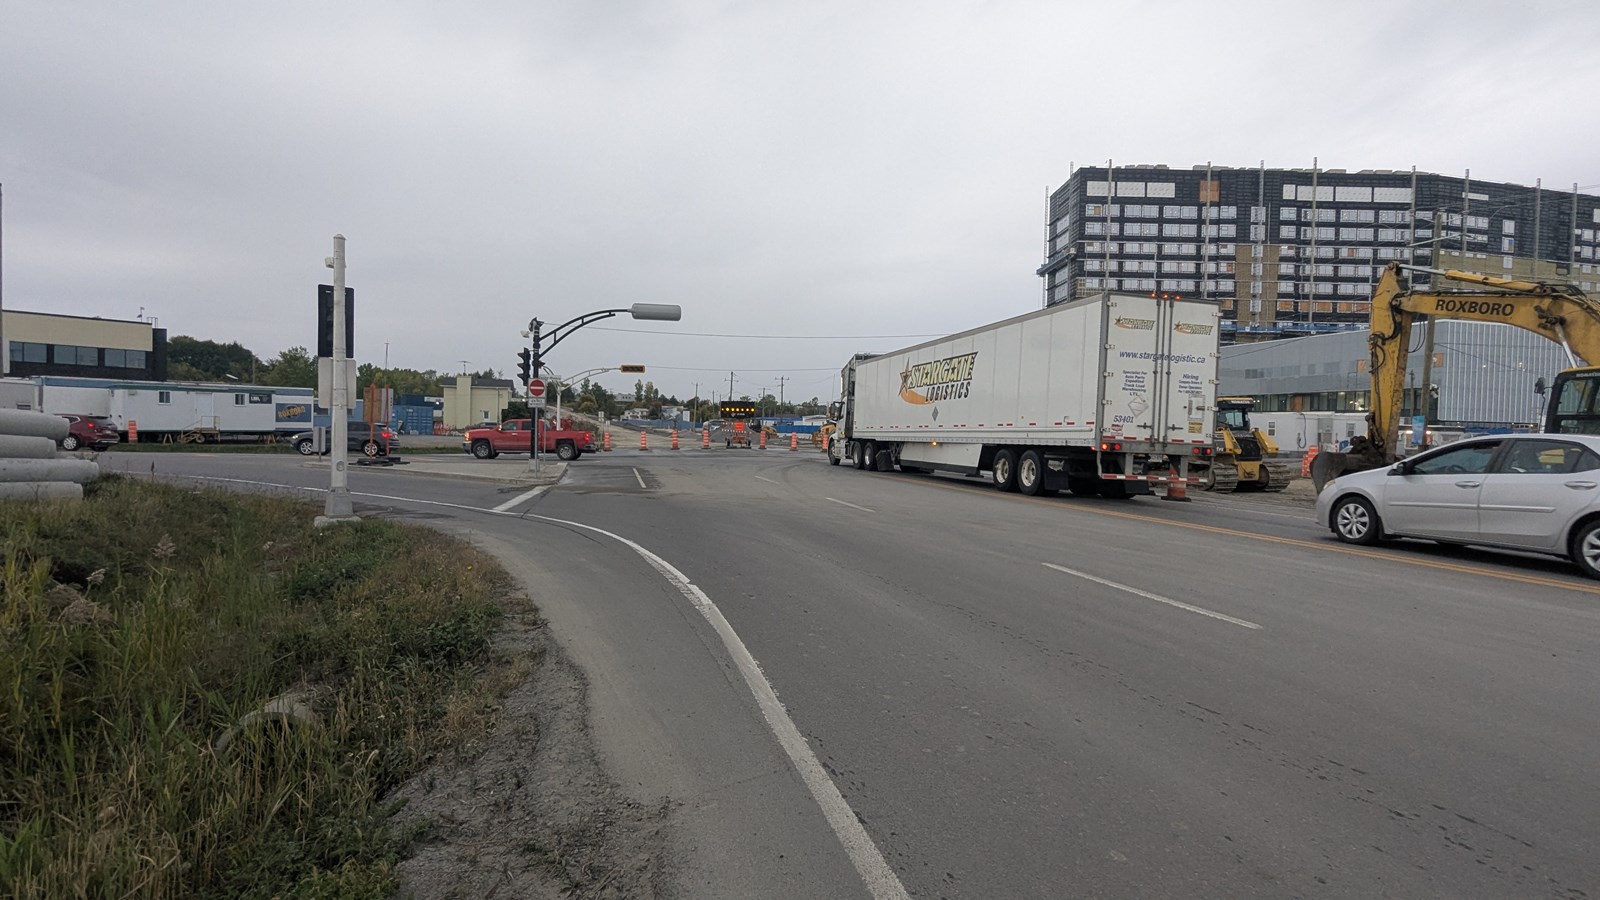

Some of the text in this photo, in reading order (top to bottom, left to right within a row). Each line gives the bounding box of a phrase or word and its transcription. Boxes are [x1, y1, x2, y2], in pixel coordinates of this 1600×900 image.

[1435, 299, 1515, 316] ROXBORO
[908, 352, 978, 389] STARGATE
[925, 381, 971, 401] LOGISTICS
[1113, 415, 1134, 424] 53401
